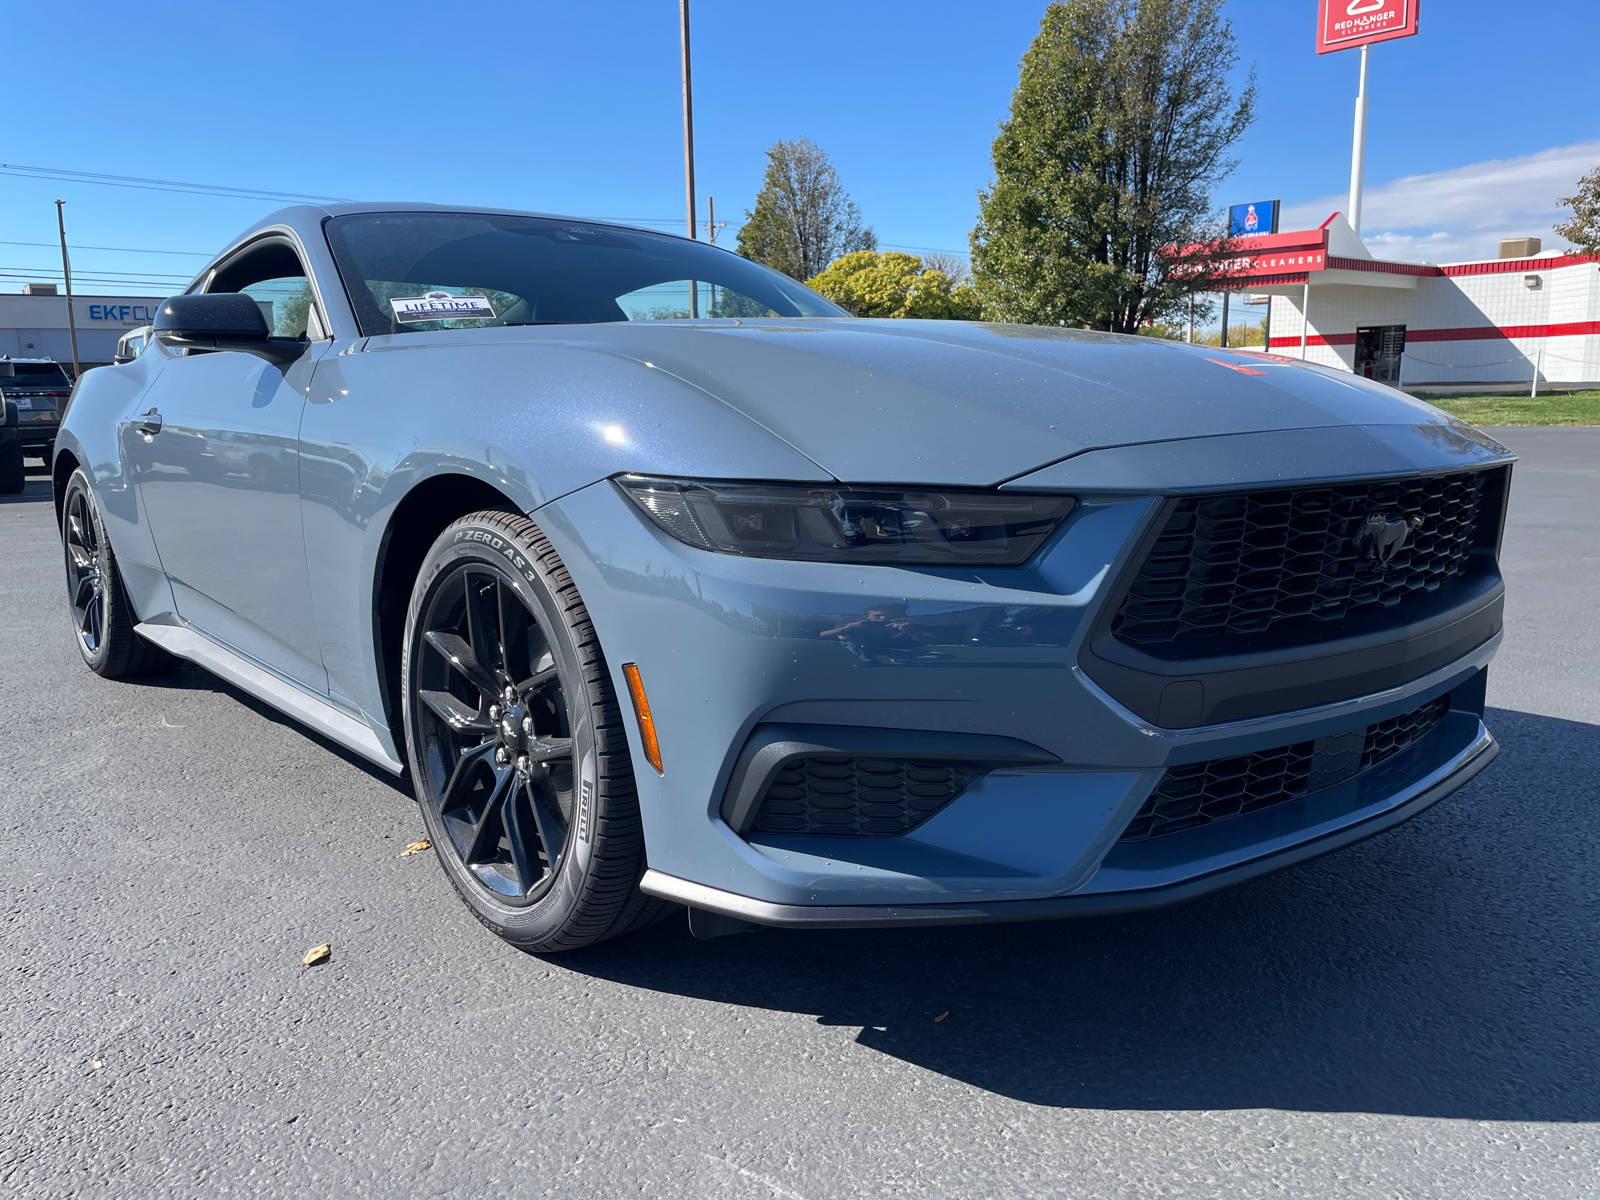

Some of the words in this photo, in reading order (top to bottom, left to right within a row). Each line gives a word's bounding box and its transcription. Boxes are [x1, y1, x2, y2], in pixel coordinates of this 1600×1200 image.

[1334, 20, 1353, 31] RED
[1342, 21, 1387, 35] CLEANERS
[1253, 255, 1322, 269] CLEANERS
[405, 301, 480, 311] LIFETIME
[454, 531, 463, 543] P
[464, 530, 504, 550] ZERO
[503, 548, 526, 569] AS
[524, 570, 536, 582] 3
[579, 779, 593, 844] PIRELLI
